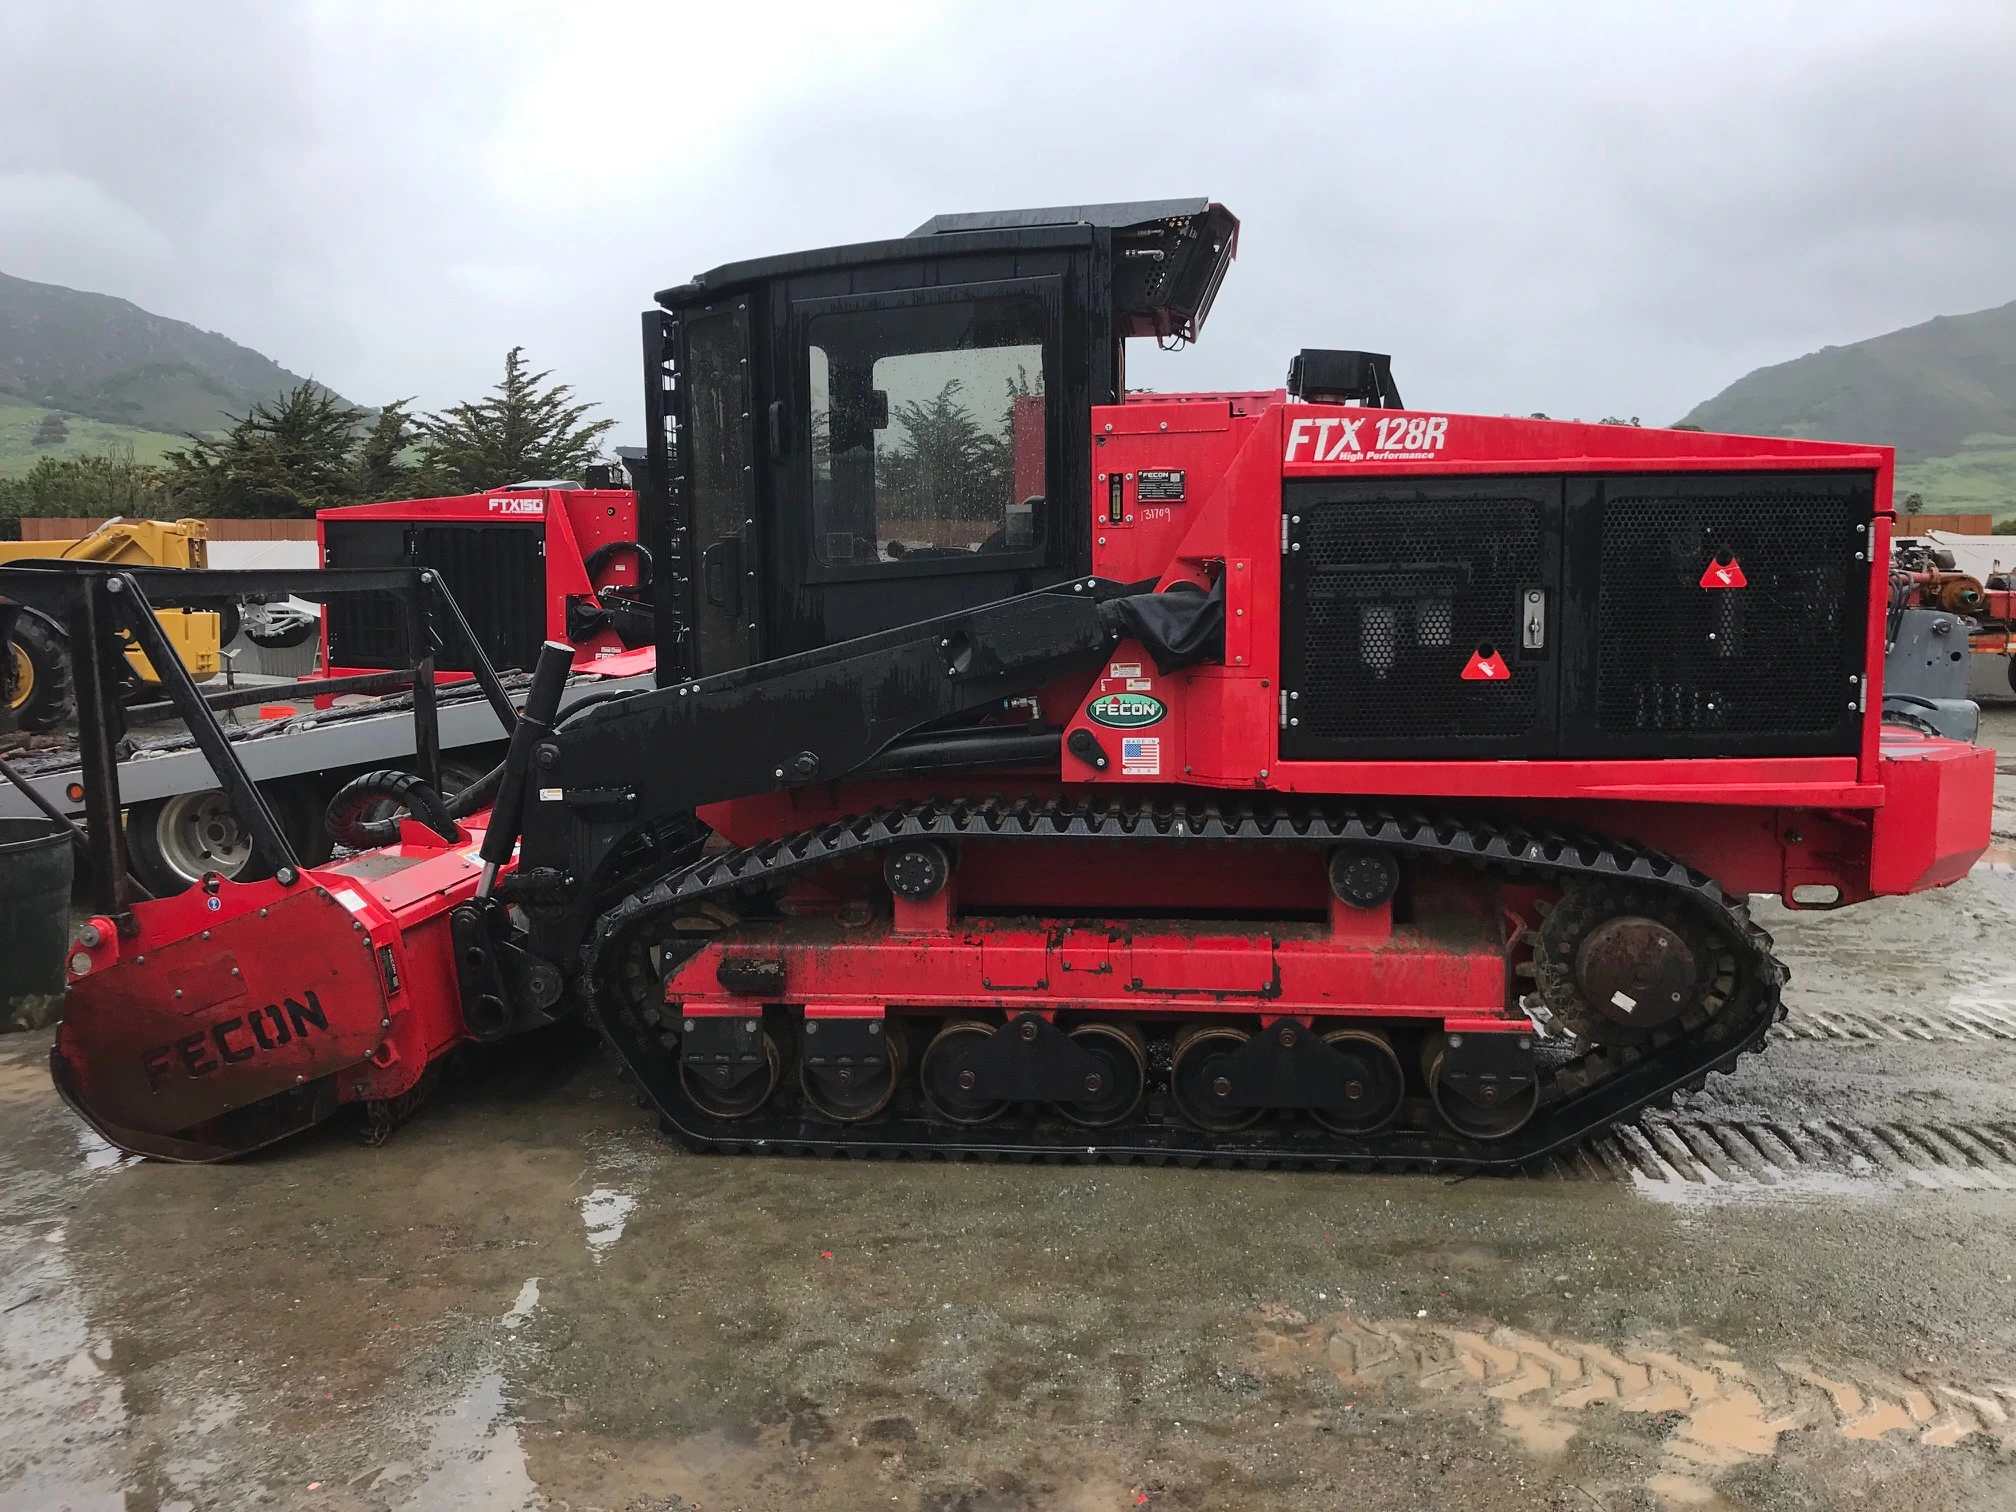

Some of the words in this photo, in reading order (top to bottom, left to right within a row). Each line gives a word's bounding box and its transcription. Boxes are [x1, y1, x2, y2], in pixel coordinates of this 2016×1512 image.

[1285, 417, 1366, 461] FTX
[1375, 416, 1448, 450] 128R
[1338, 451, 1363, 463] High
[1366, 450, 1435, 460] Performance
[1095, 703, 1156, 716] FECON
[140, 989, 329, 1094] FECON
